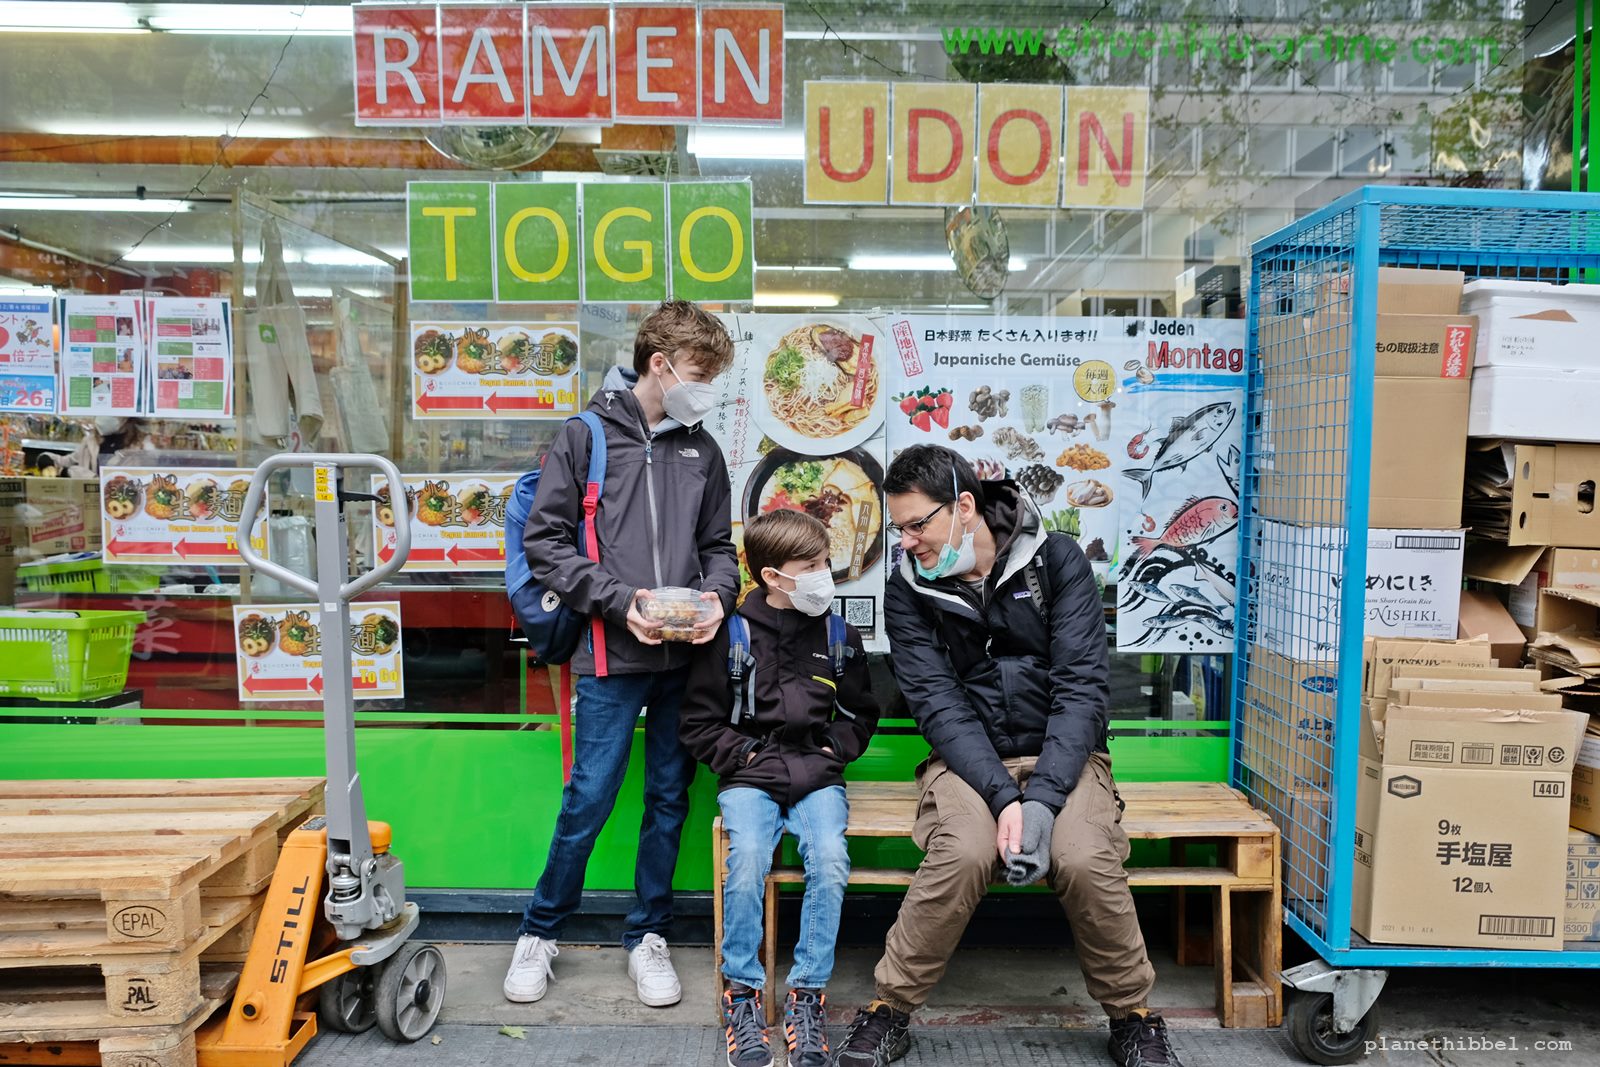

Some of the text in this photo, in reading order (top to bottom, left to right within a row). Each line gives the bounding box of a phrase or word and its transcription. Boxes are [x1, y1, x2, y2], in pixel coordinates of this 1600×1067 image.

[941, 20, 1502, 65] www.shochiku-online.com
[373, 25, 770, 105] RAMEN
[819, 105, 1134, 187] UDON
[925, 329, 1098, 342] 日本野菜 たくさん入ります!!
[1150, 320, 1194, 336] Jeden
[479, 341, 557, 376] 生麺
[933, 352, 1081, 367] Japanische Gemüse
[1147, 340, 1244, 373] Montag
[16, 390, 43, 406] 26
[537, 389, 576, 404] To Go
[1369, 605, 1437, 627] NISHIKI
[360, 669, 398, 683] To Go
[1539, 783, 1559, 795] 440
[1438, 819, 1461, 836] 9枚
[1436, 841, 1513, 868] 手塩屋
[1452, 877, 1493, 894] 12個入
[121, 911, 160, 930] EPAL
[269, 875, 310, 984] STILL
